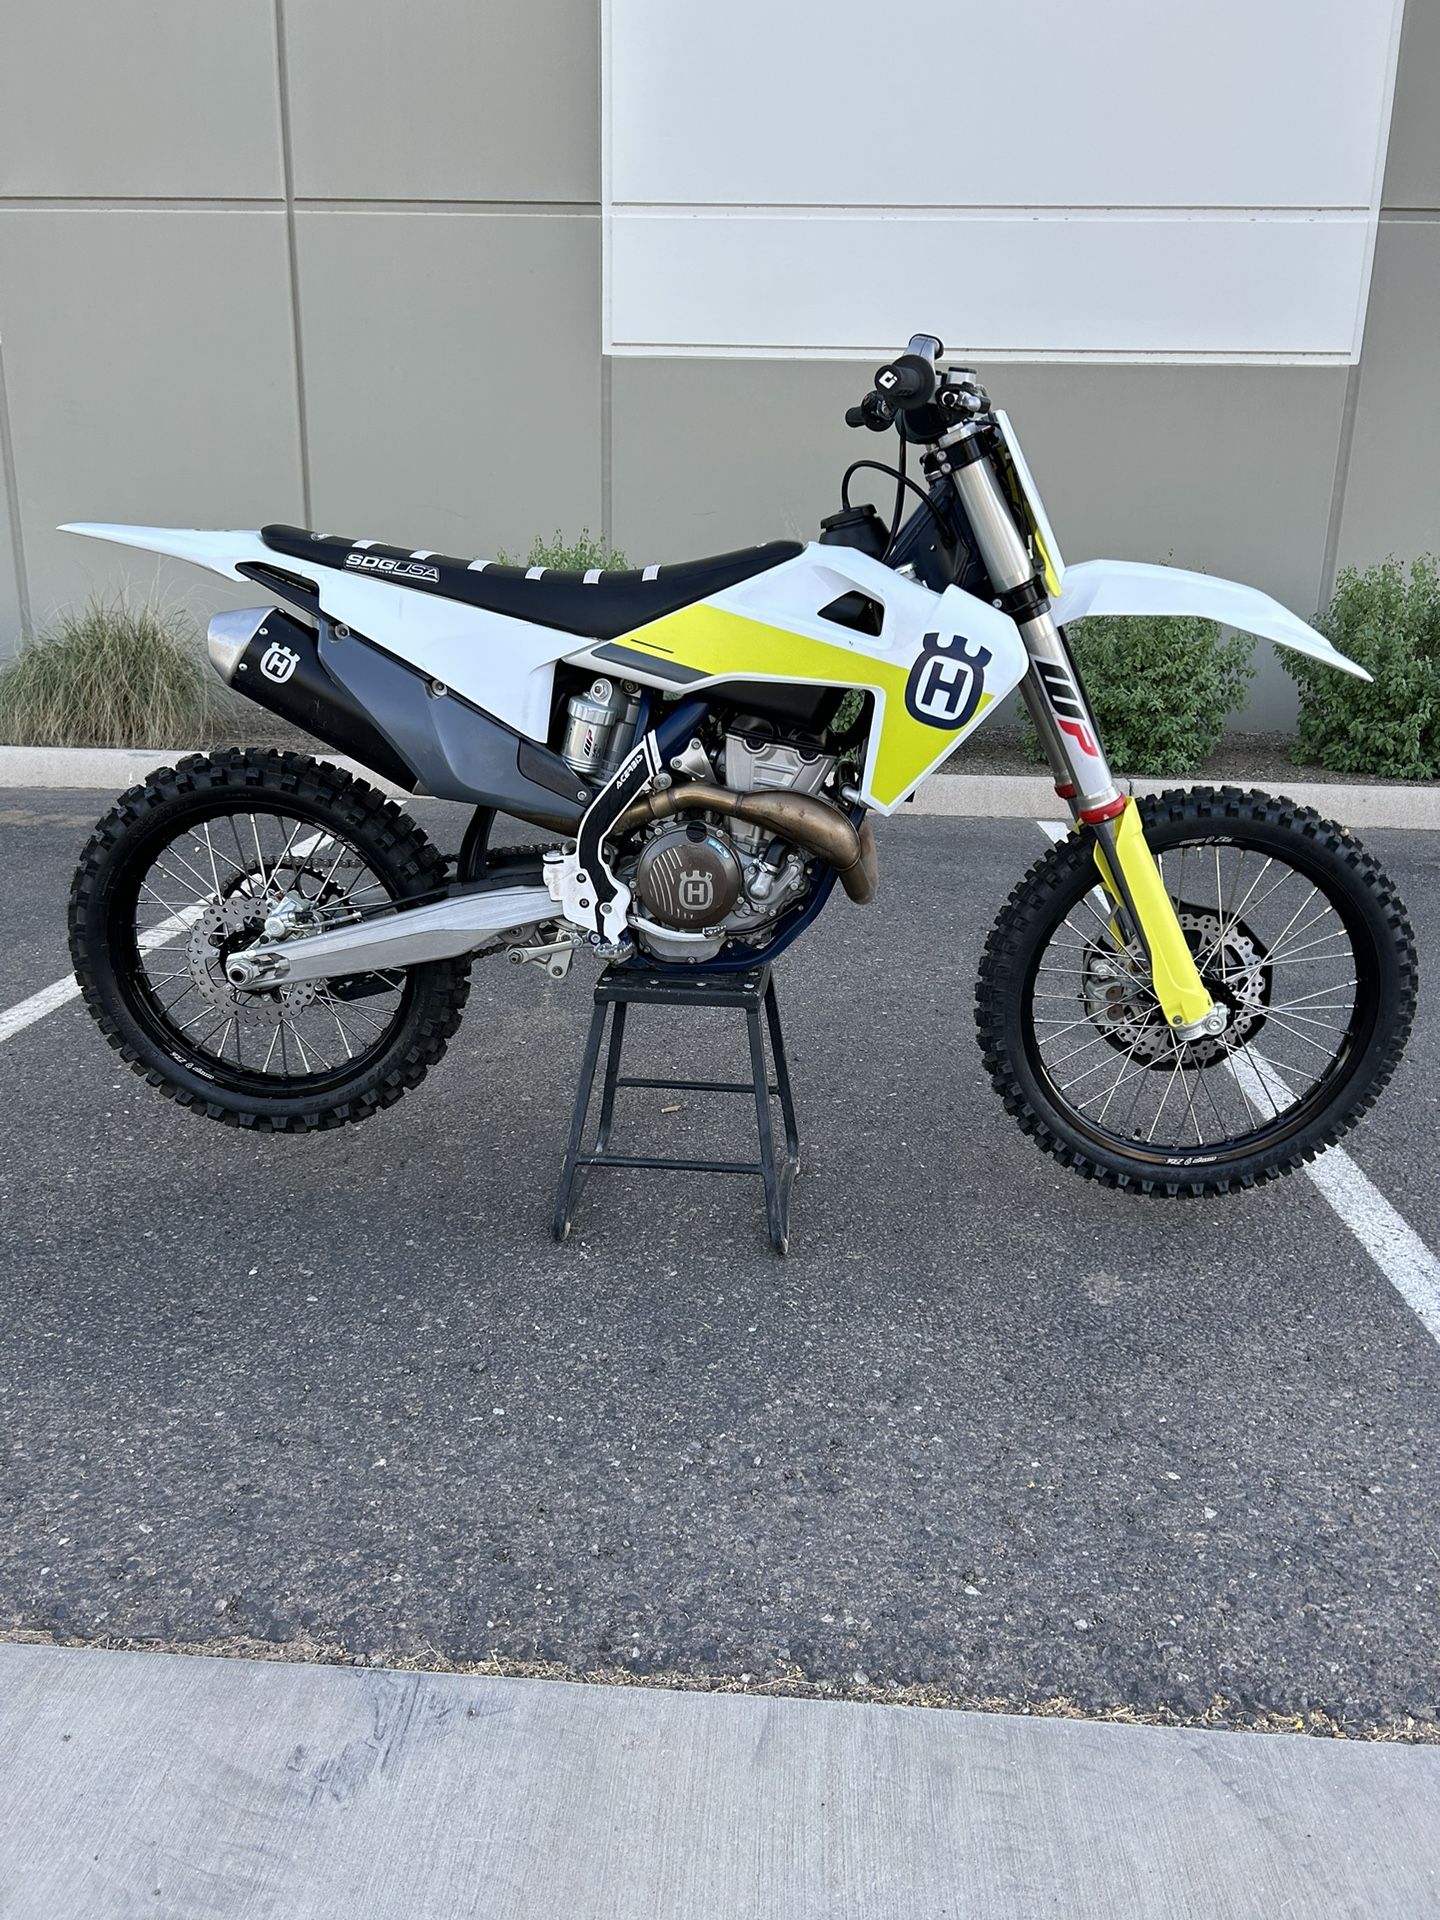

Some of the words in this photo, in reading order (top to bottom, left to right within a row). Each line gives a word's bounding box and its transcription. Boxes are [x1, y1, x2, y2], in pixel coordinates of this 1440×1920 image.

[921, 661, 968, 714] H
[1035, 659, 1099, 758] WP
[616, 753, 644, 790] ACERBIS
